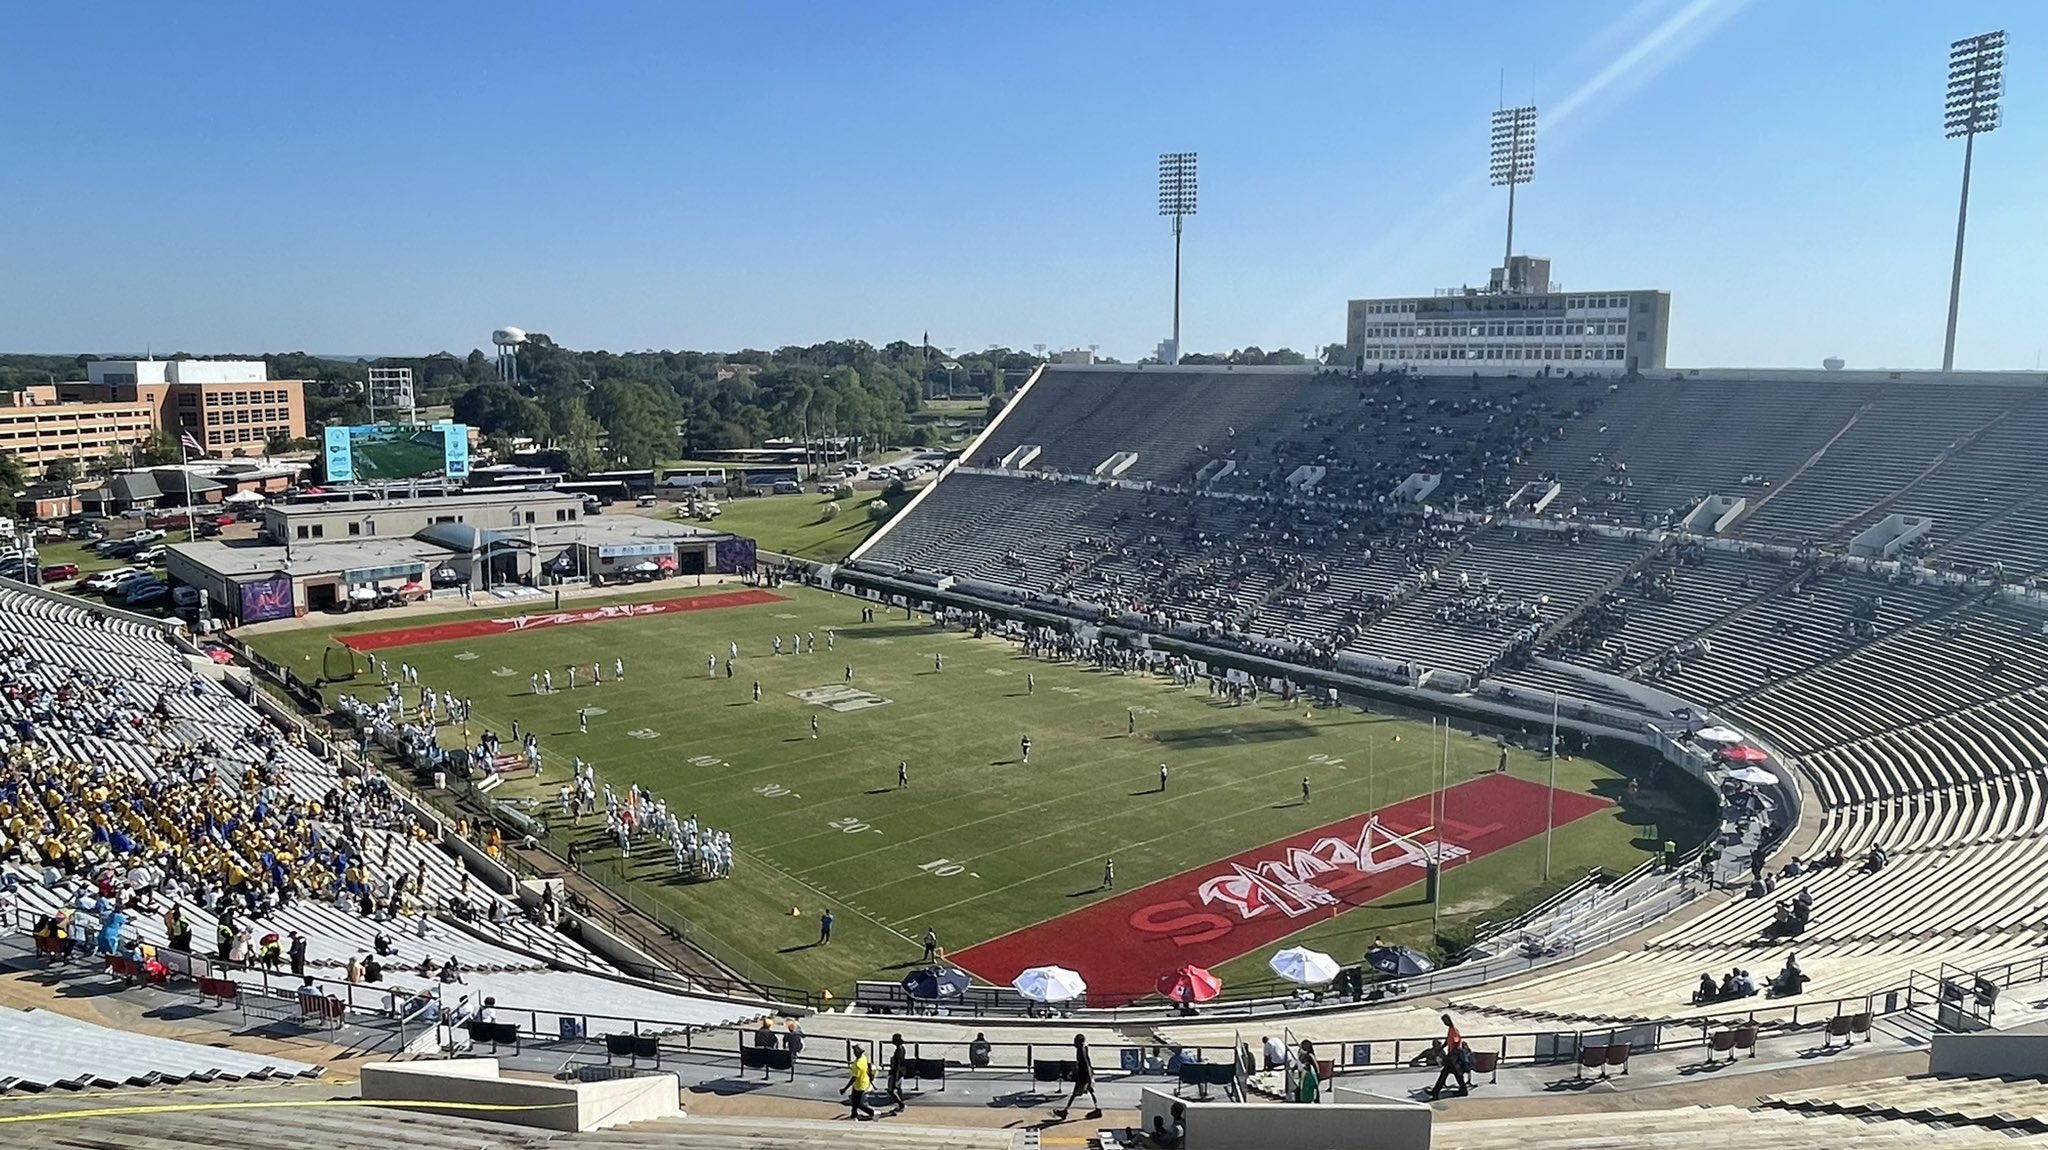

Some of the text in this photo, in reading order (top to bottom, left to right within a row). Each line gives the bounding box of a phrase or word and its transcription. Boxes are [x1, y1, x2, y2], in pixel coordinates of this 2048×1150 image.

[752, 783, 791, 798] 30
[827, 817, 871, 834] 20
[917, 858, 966, 877] 10
